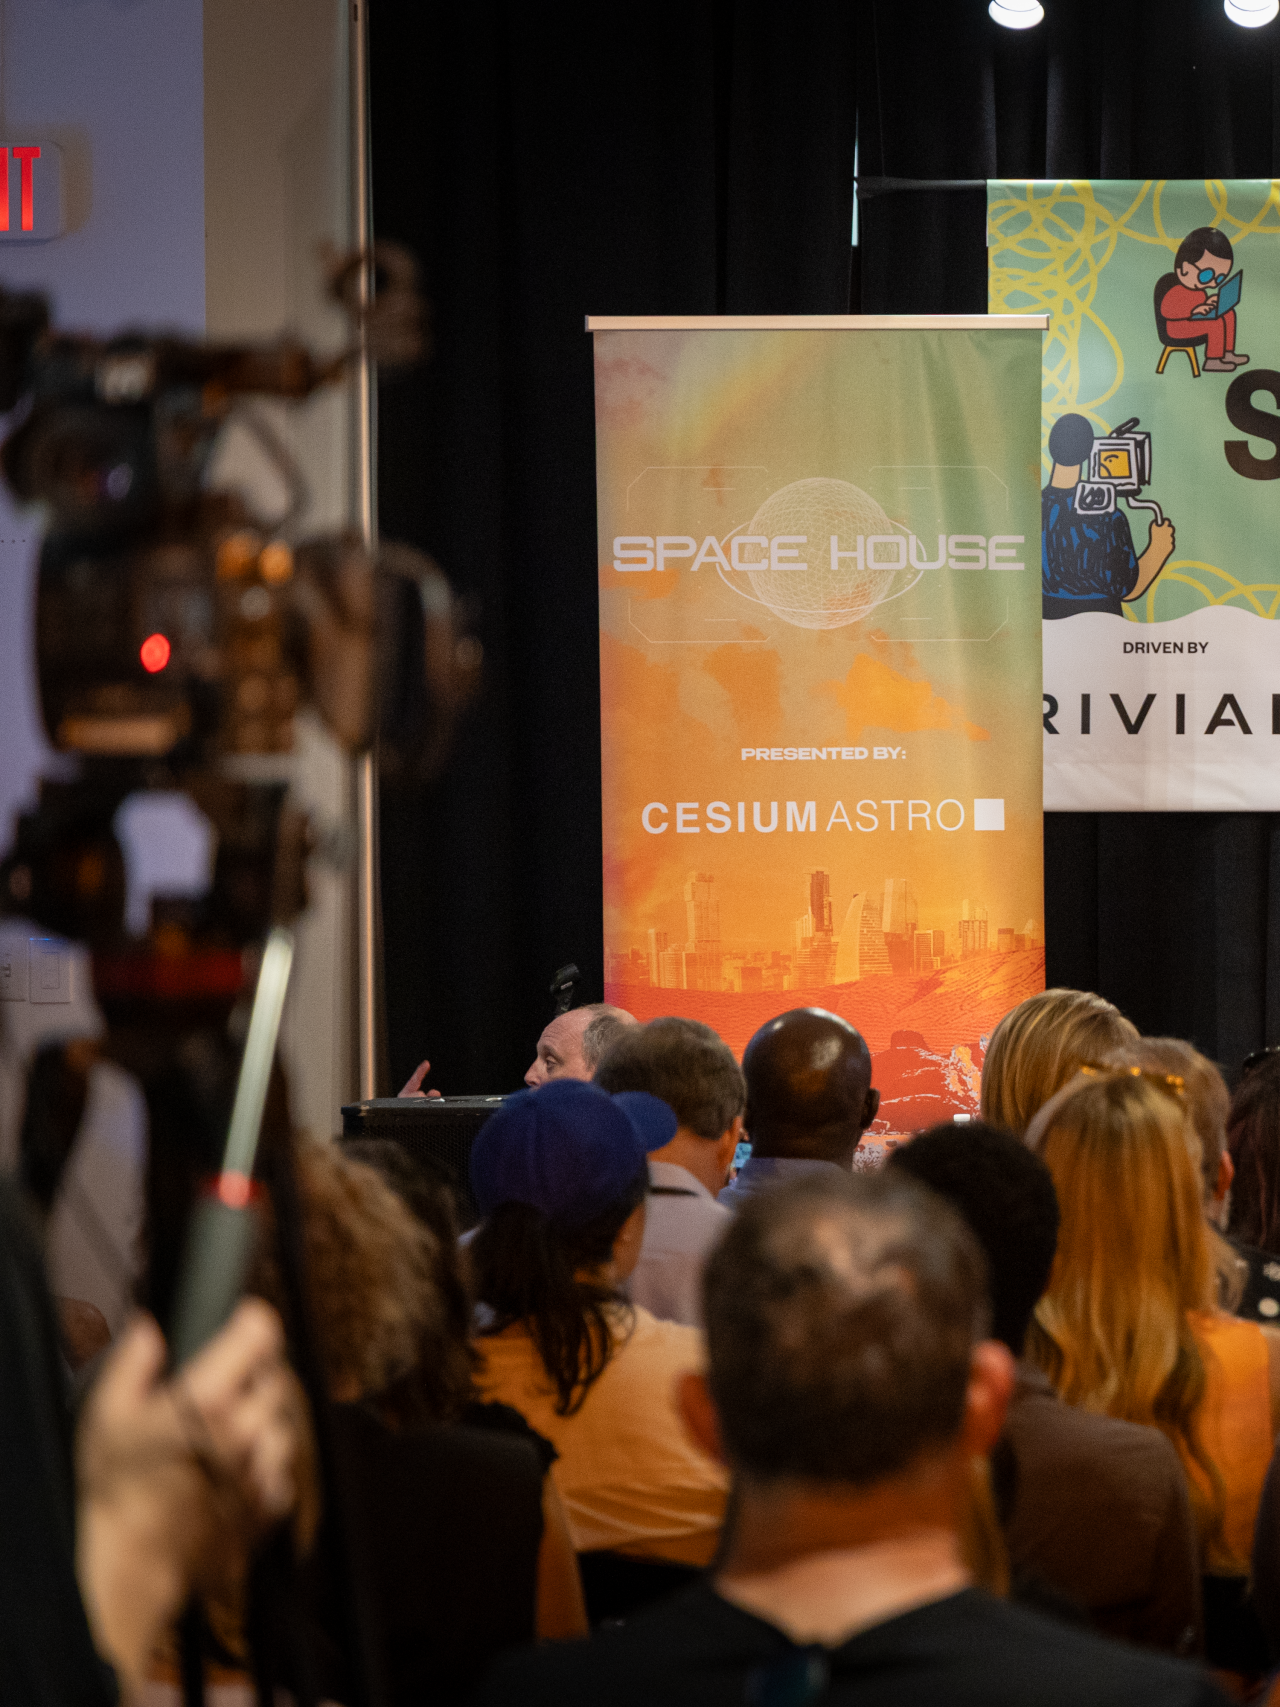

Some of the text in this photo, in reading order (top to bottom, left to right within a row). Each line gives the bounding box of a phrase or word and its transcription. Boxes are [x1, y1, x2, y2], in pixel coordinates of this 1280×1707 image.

[0, 147, 41, 231] IT
[612, 534, 1026, 572] SPACE HOUSE
[1122, 641, 1209, 654] DRIVEN BY
[741, 746, 907, 761] PRESENTED BY:
